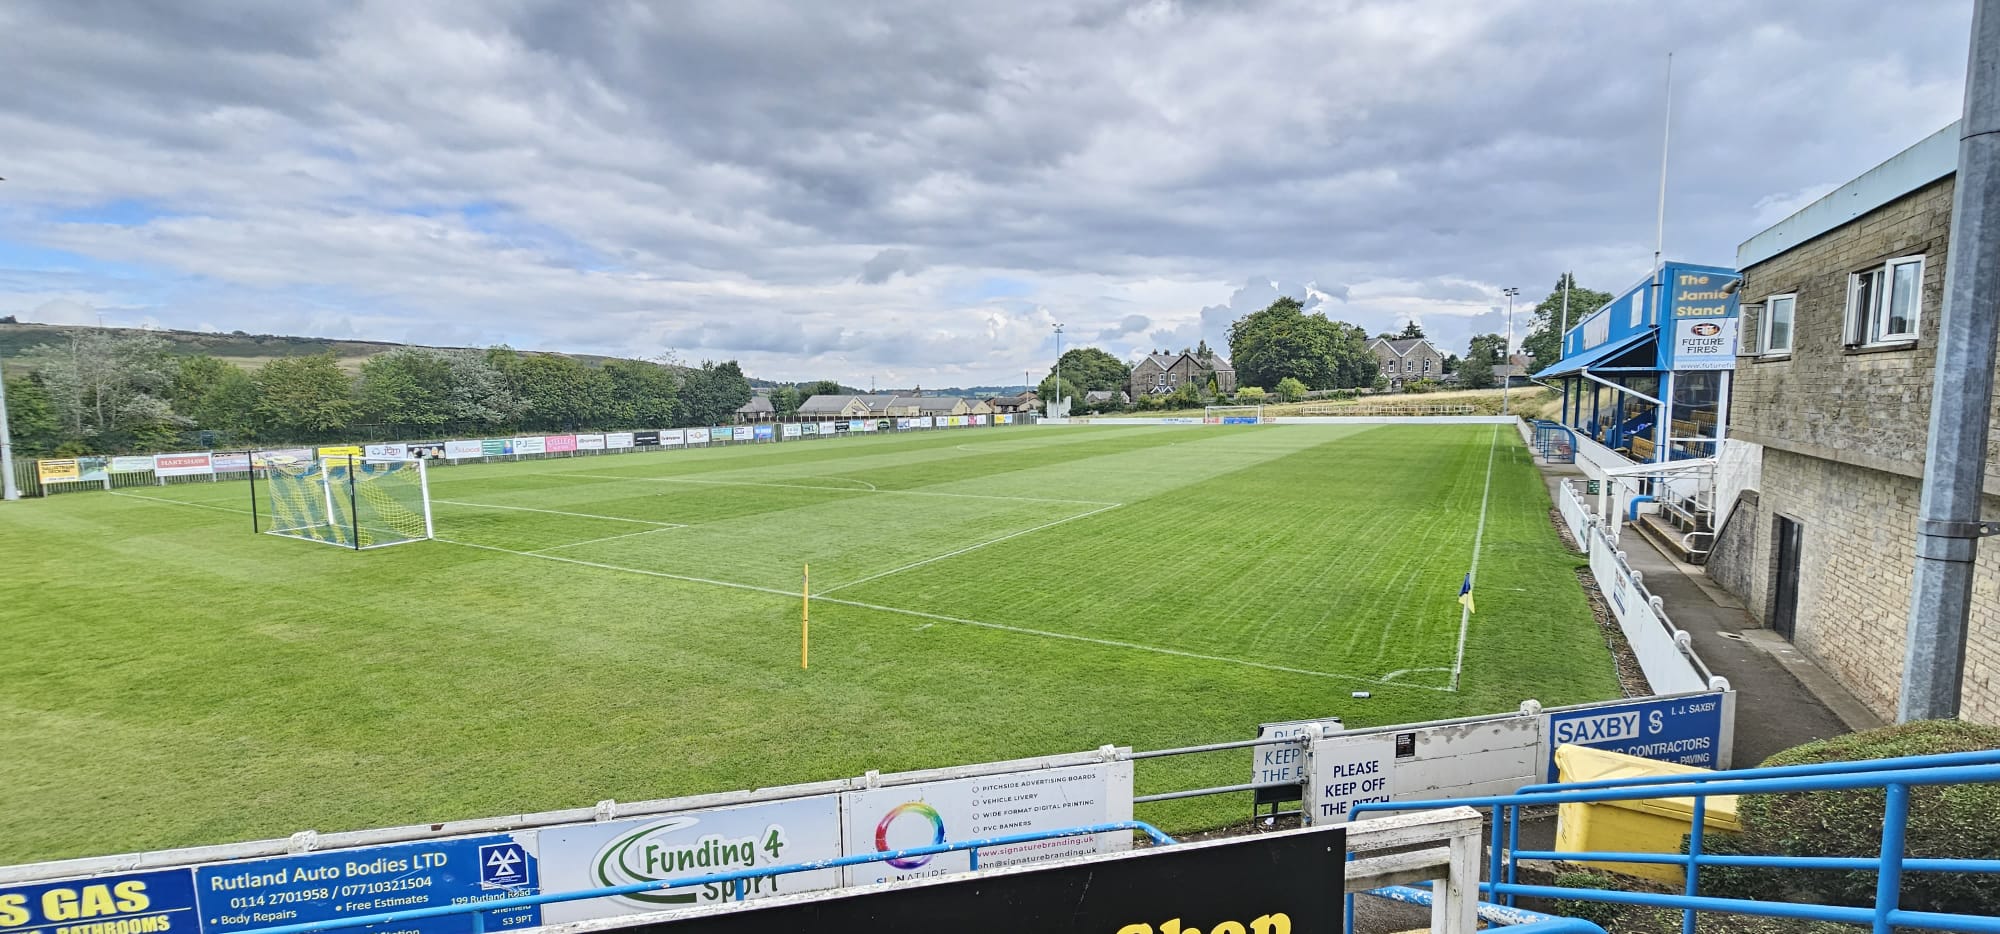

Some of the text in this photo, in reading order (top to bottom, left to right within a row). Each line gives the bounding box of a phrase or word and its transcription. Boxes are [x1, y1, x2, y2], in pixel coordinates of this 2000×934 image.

[1680, 275, 1709, 286] The
[1678, 291, 1728, 301] Jamie
[1677, 305, 1726, 317] Stand
[1682, 338, 1725, 346] FUTURE
[1687, 346, 1718, 354] FIRES
[1689, 702, 1716, 713] SAXBY
[1557, 714, 1637, 744] SAXBY
[1628, 736, 1711, 758] CONTRACTORS
[1264, 748, 1301, 766] KEEP
[1680, 752, 1710, 765] PAVING
[1262, 767, 1290, 783] THE
[1333, 760, 1379, 778] PLEASE
[982, 773, 1096, 791] PITCHSIDE ADVERTISING BOARDS
[1325, 777, 1386, 798] KEEP OFF
[983, 793, 1039, 805] VEHICLE LIVERY
[1003, 807, 1032, 815] FORMAT
[1034, 803, 1061, 812] DIGITAL
[1062, 799, 1095, 808] PRINTING
[1320, 794, 1390, 817] THE PTCH
[999, 820, 1032, 830] BANNERS
[645, 829, 784, 875] Funding 4
[978, 847, 1097, 870] ohn@signaturebranding.uk
[211, 852, 448, 891] Rutland Auto Bodies LTD
[230, 876, 433, 909] 0114 2701958 / 07710321504
[470, 891, 505, 904] Rutland
[41, 880, 150, 922] GAS
[346, 894, 429, 912] Free Estimates
[221, 909, 297, 925] Body Repairs
[502, 914, 533, 926] S3 9PT
